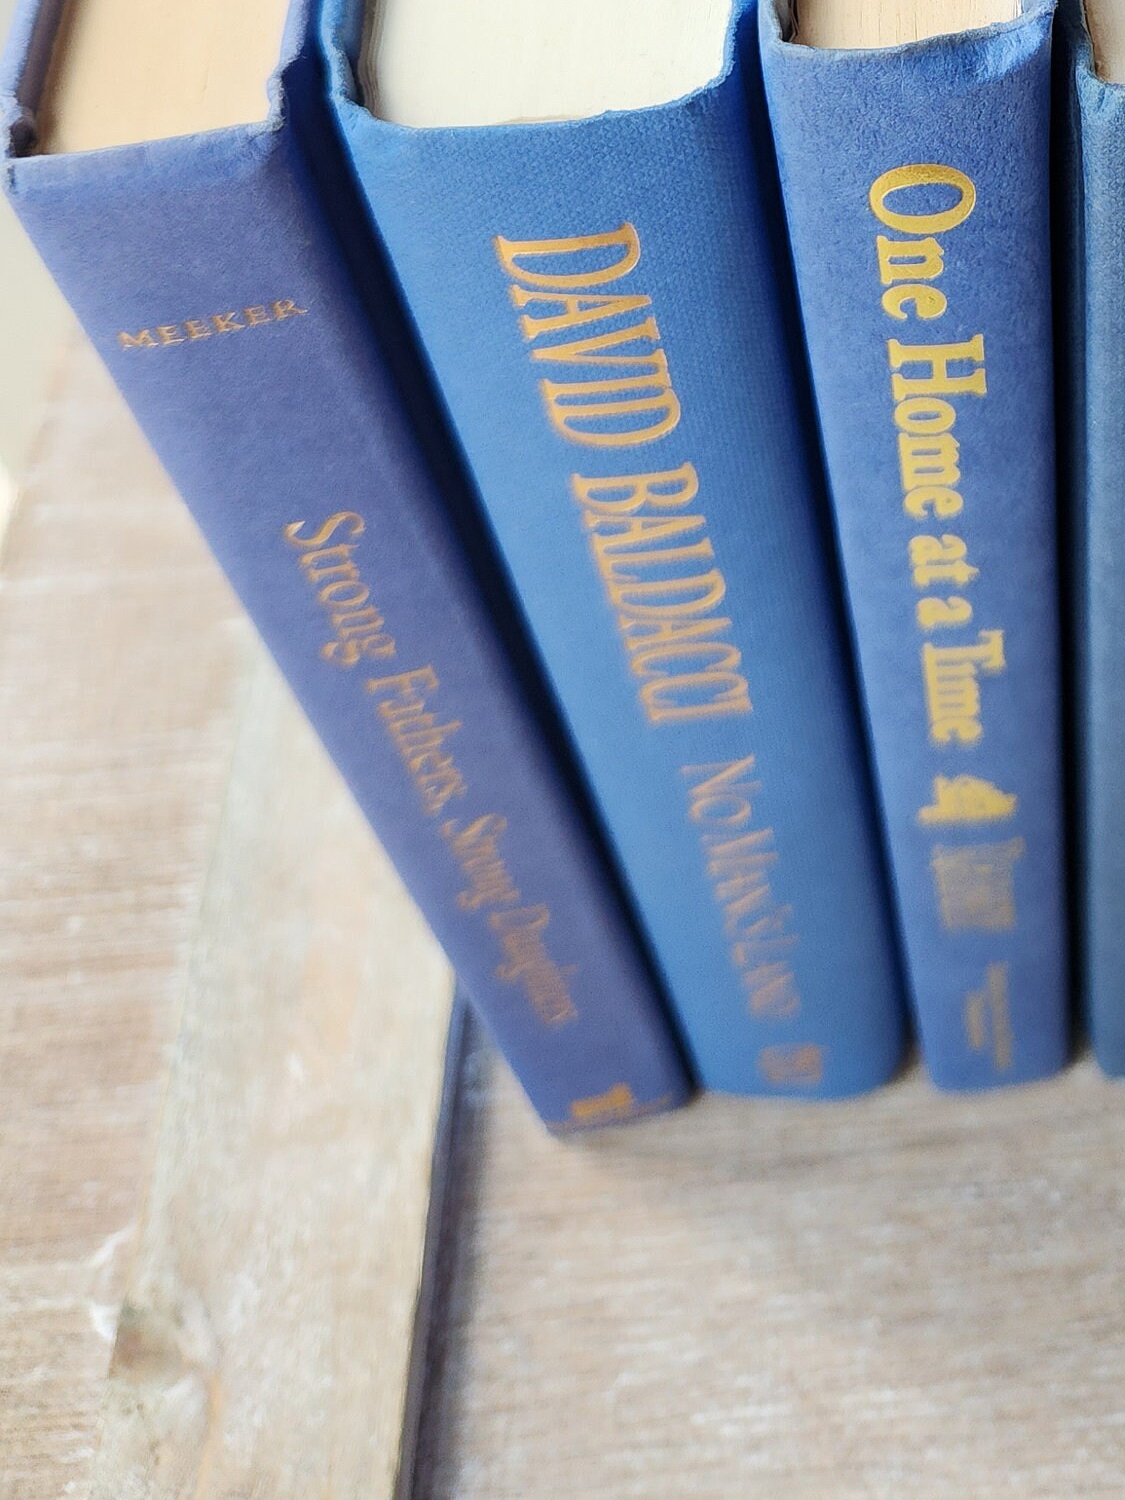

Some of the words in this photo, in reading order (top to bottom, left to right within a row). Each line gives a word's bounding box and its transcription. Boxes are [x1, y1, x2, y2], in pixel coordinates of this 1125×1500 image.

[869, 163, 976, 320] One
[117, 298, 309, 349] MEEKER
[495, 222, 682, 448] DAVID
[887, 334, 988, 521] Home
[283, 510, 397, 668] Strong
[571, 461, 755, 725] BALDACCI
[907, 533, 981, 588] at
[915, 595, 974, 632] a
[921, 629, 1006, 746] Time
